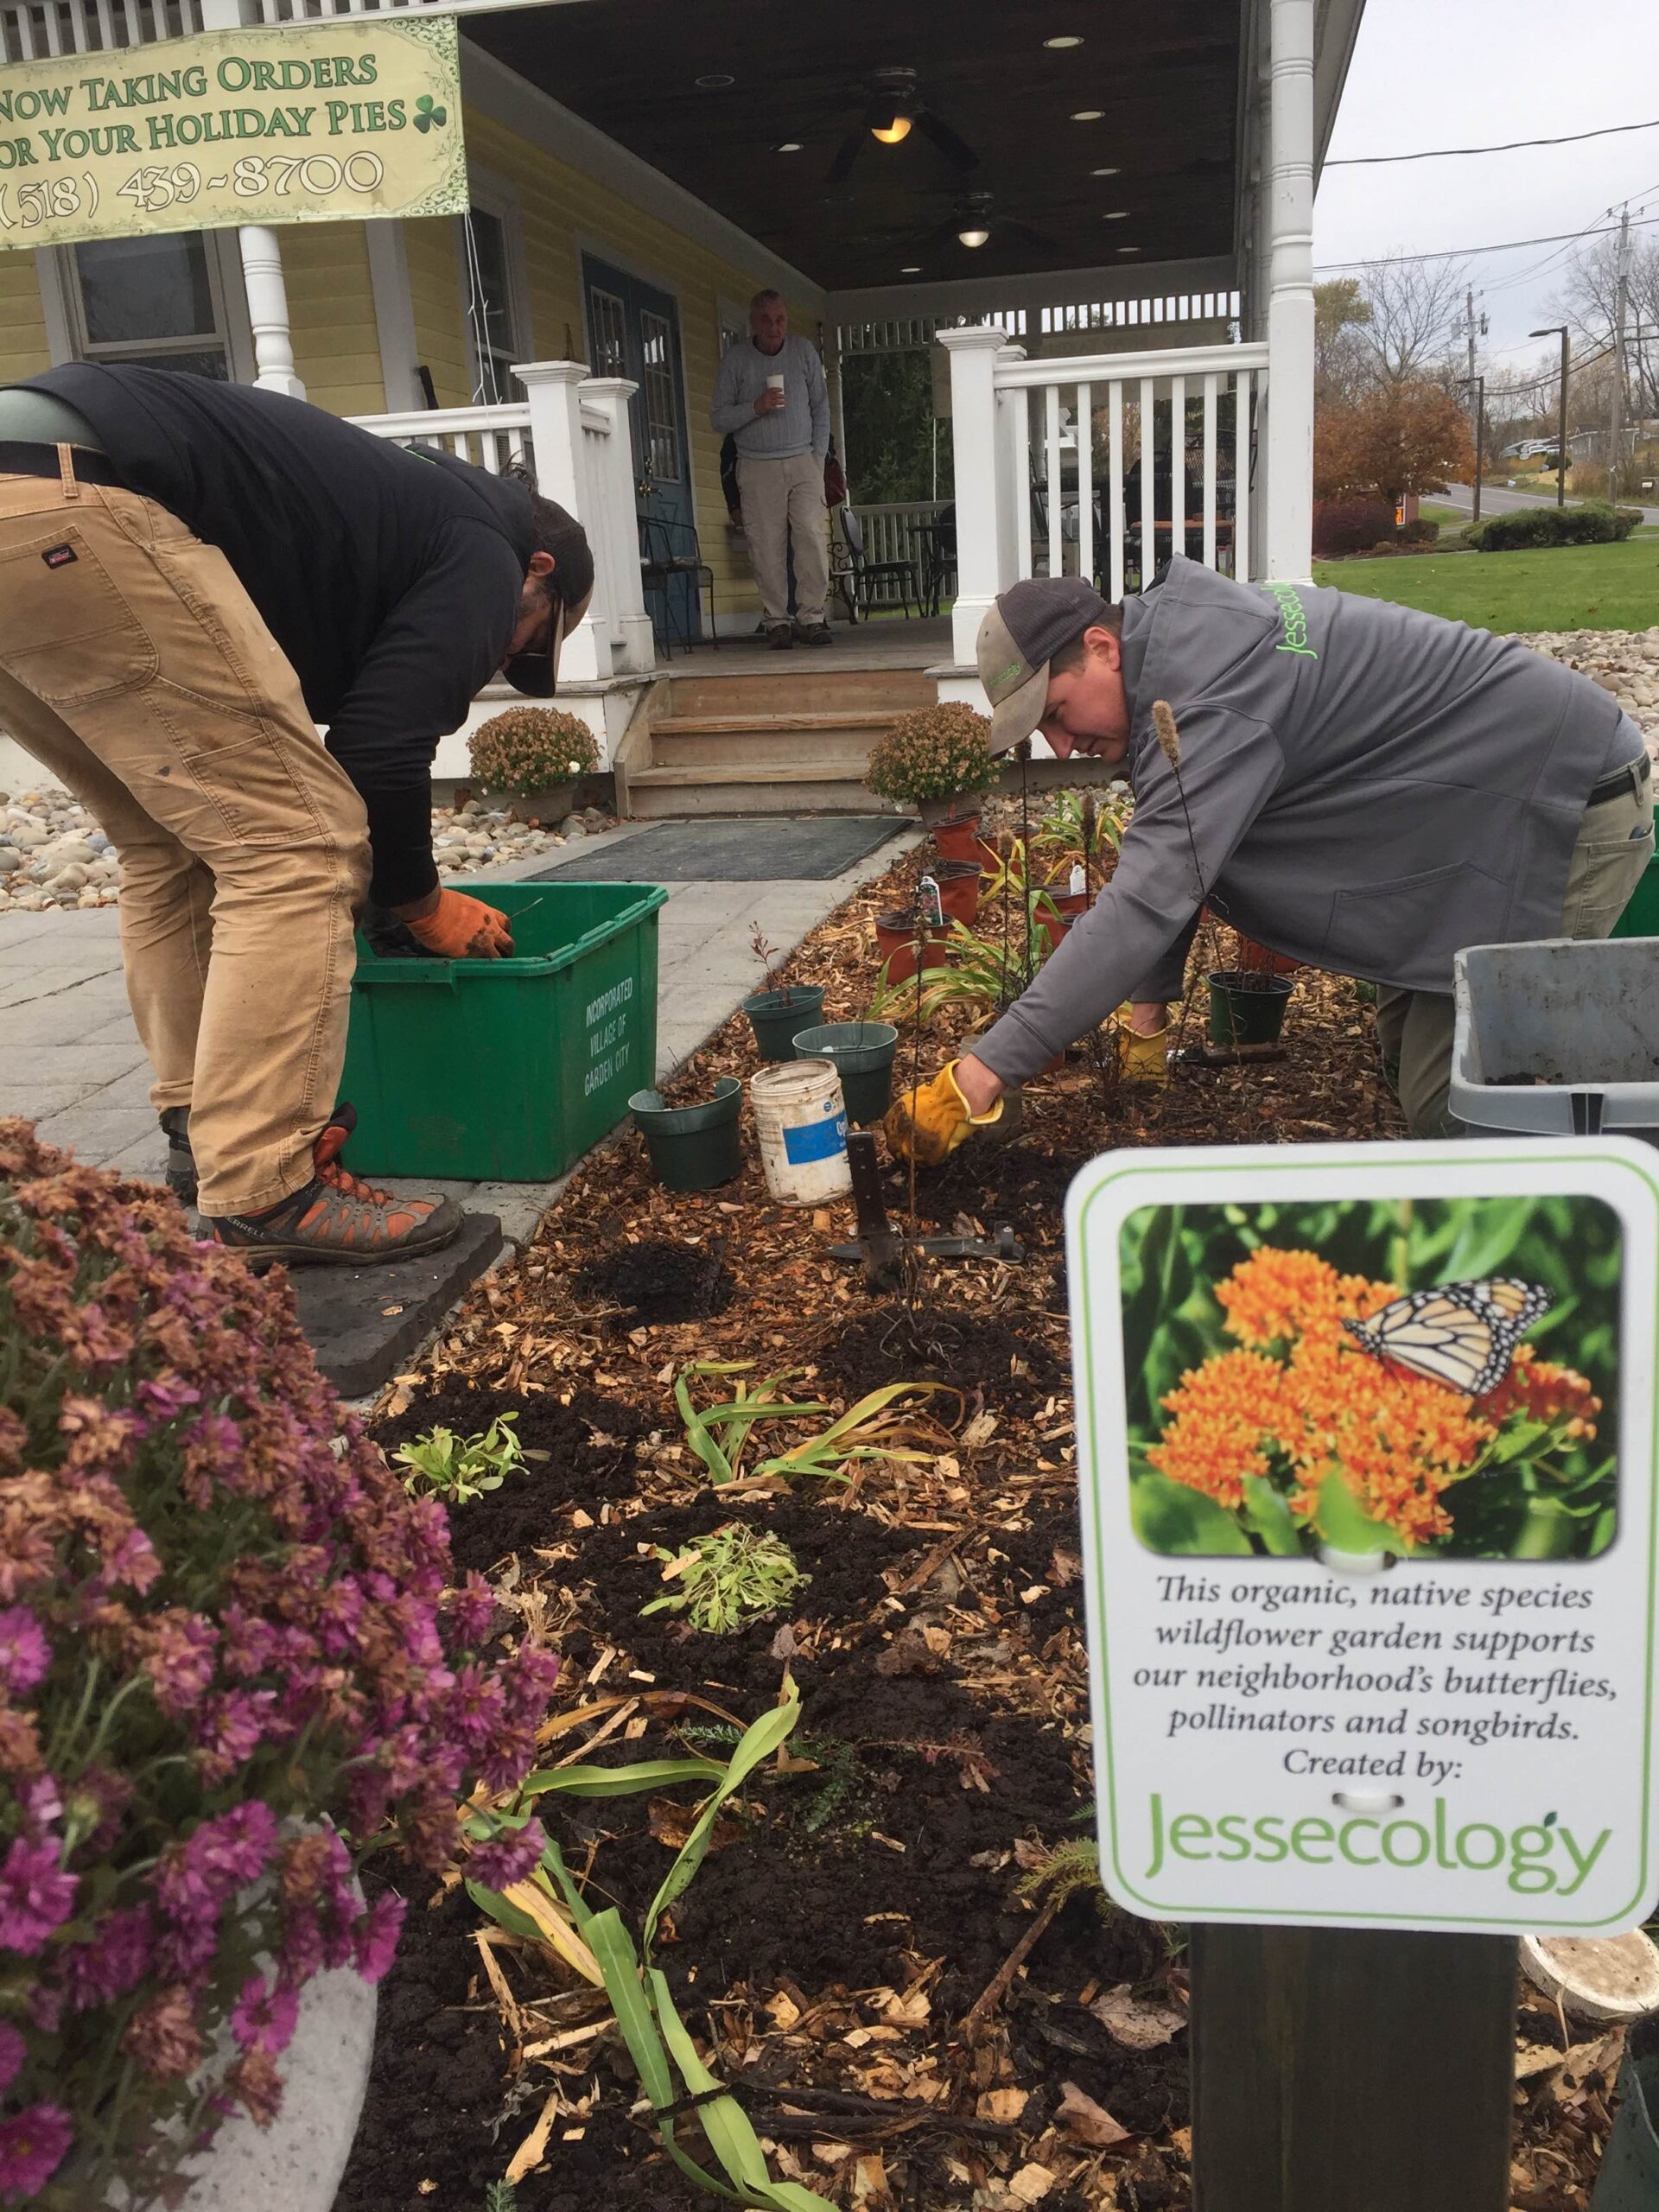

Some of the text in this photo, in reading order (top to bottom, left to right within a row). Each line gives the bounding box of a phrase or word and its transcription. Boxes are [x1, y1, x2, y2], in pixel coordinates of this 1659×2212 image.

[79, 67, 207, 111] TAKING
[217, 54, 378, 92] ORDERS
[0, 99, 407, 168] OR YOUR HOLIDAY PIES
[0, 150, 384, 230] (518) 439-8700
[586, 976, 632, 1028] INCORPORATED
[590, 1013, 626, 1058] VILLAGE OF
[584, 1041, 630, 1096] GARDEN CITY
[224, 1216, 265, 1239] ERRELL
[1157, 1574, 1594, 1617] This organic, native species
[1155, 1618, 1596, 1661] wildflower garden supports
[1133, 1662, 1618, 1705] our neighborhood's butterflies,
[1166, 1703, 1580, 1746] pollinators and songbirds.
[1283, 1749, 1464, 1787] Created by:
[1145, 1793, 1613, 1897] Jessecology
